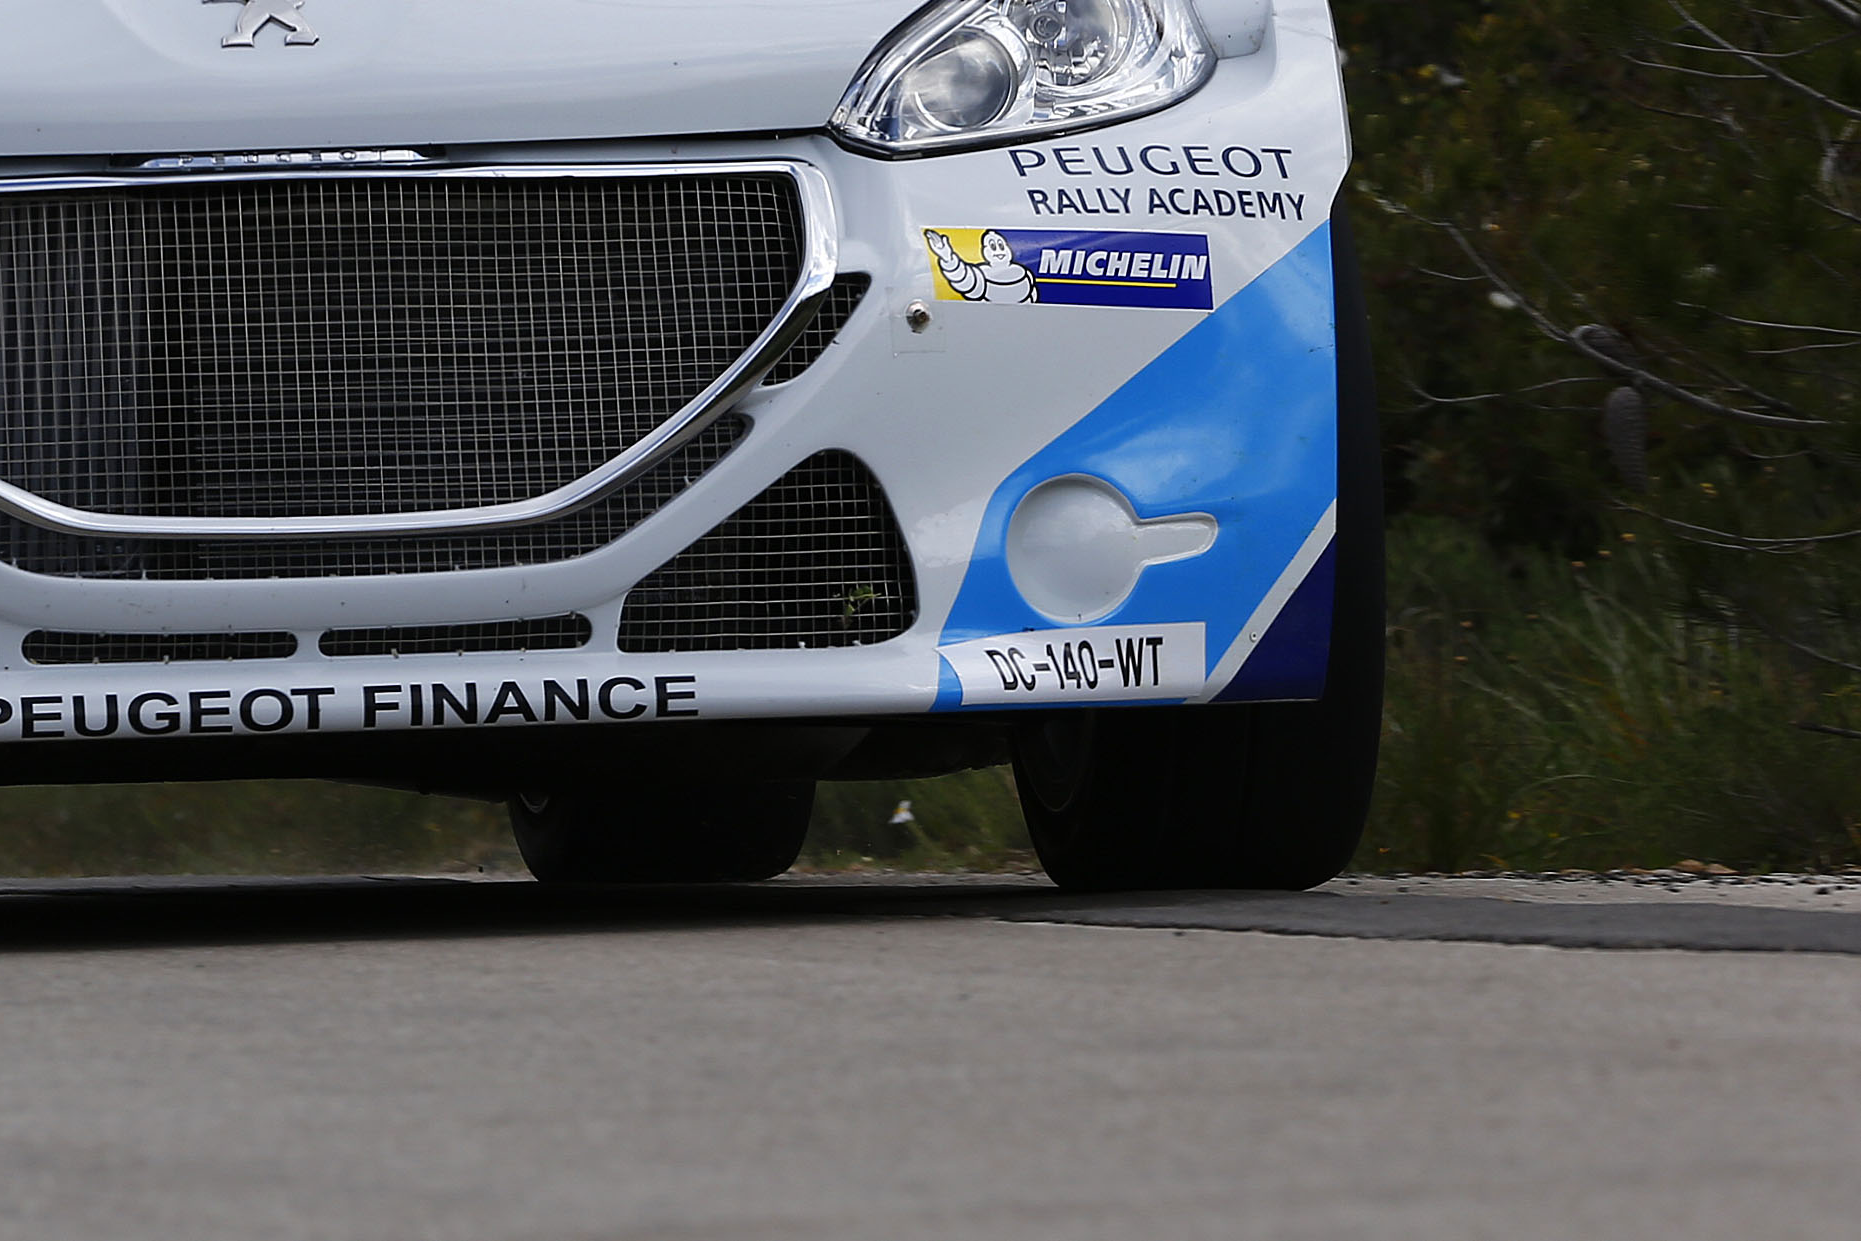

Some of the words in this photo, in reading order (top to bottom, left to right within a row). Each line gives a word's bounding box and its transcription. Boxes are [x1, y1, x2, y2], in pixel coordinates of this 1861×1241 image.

[1007, 144, 1293, 180] PEUGEOT
[1026, 187, 1133, 217] RALLY
[1146, 187, 1306, 222] ACADEMY
[1038, 248, 1208, 280] MICHELIN
[985, 636, 1164, 692] DC-140-WT
[362, 674, 701, 729] FINANCE
